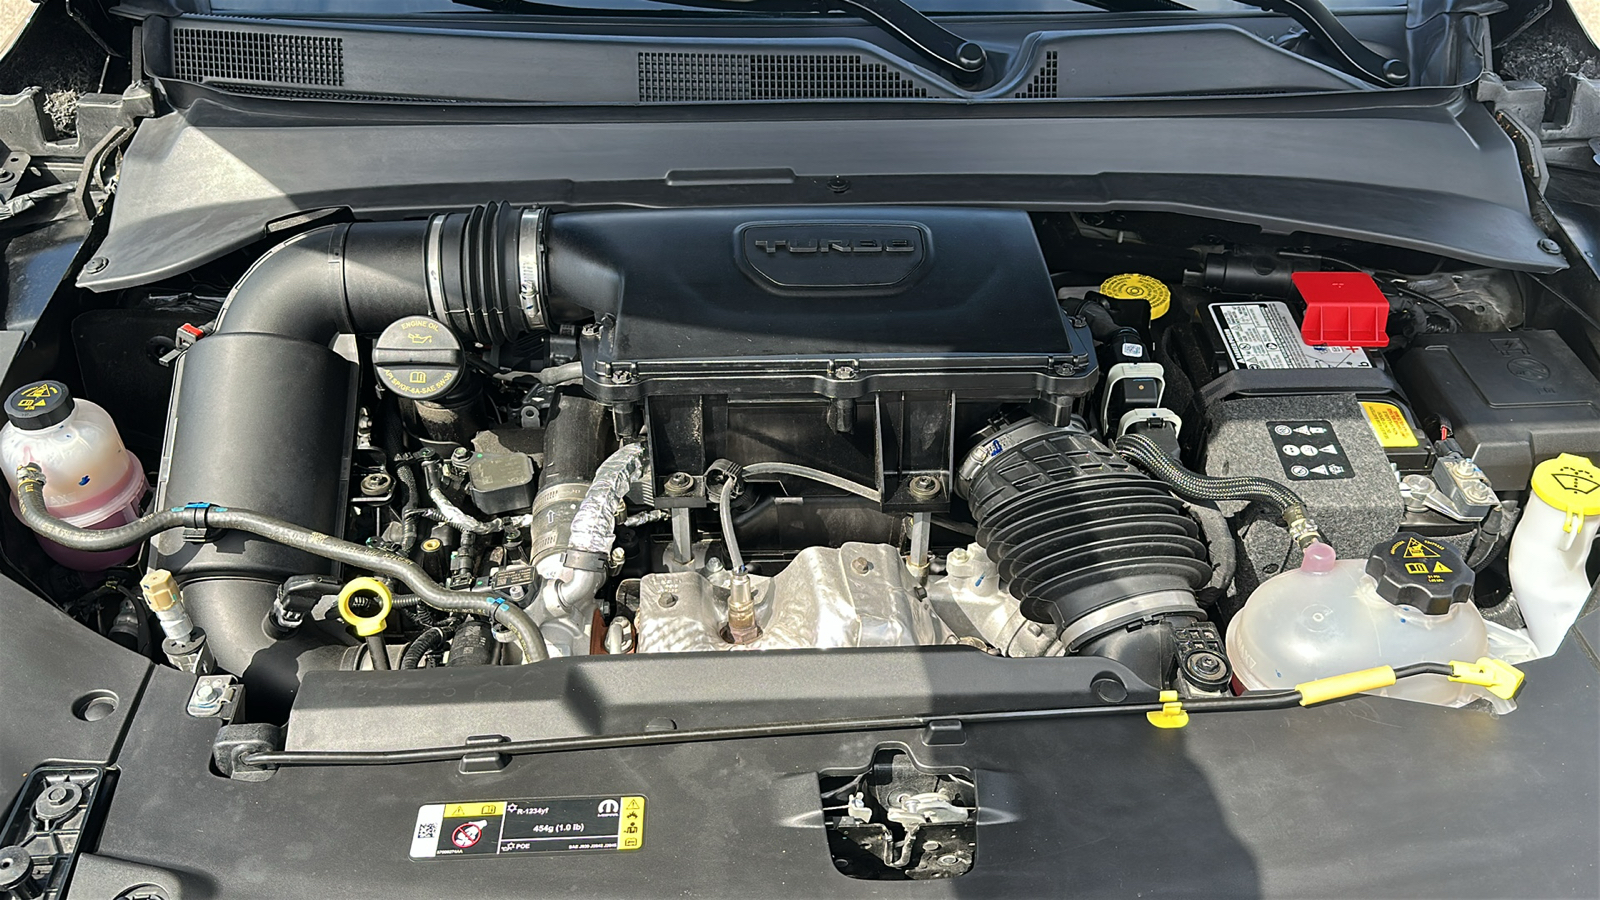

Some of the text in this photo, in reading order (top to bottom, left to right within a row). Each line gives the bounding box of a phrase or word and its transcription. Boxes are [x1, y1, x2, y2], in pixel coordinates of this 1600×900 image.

[755, 239, 914, 253] TURBO
[401, 320, 439, 332] ENGINE OIL
[383, 369, 394, 380] API
[517, 807, 549, 815] R-1234yf
[533, 823, 584, 833] 454g (1.0 lb)
